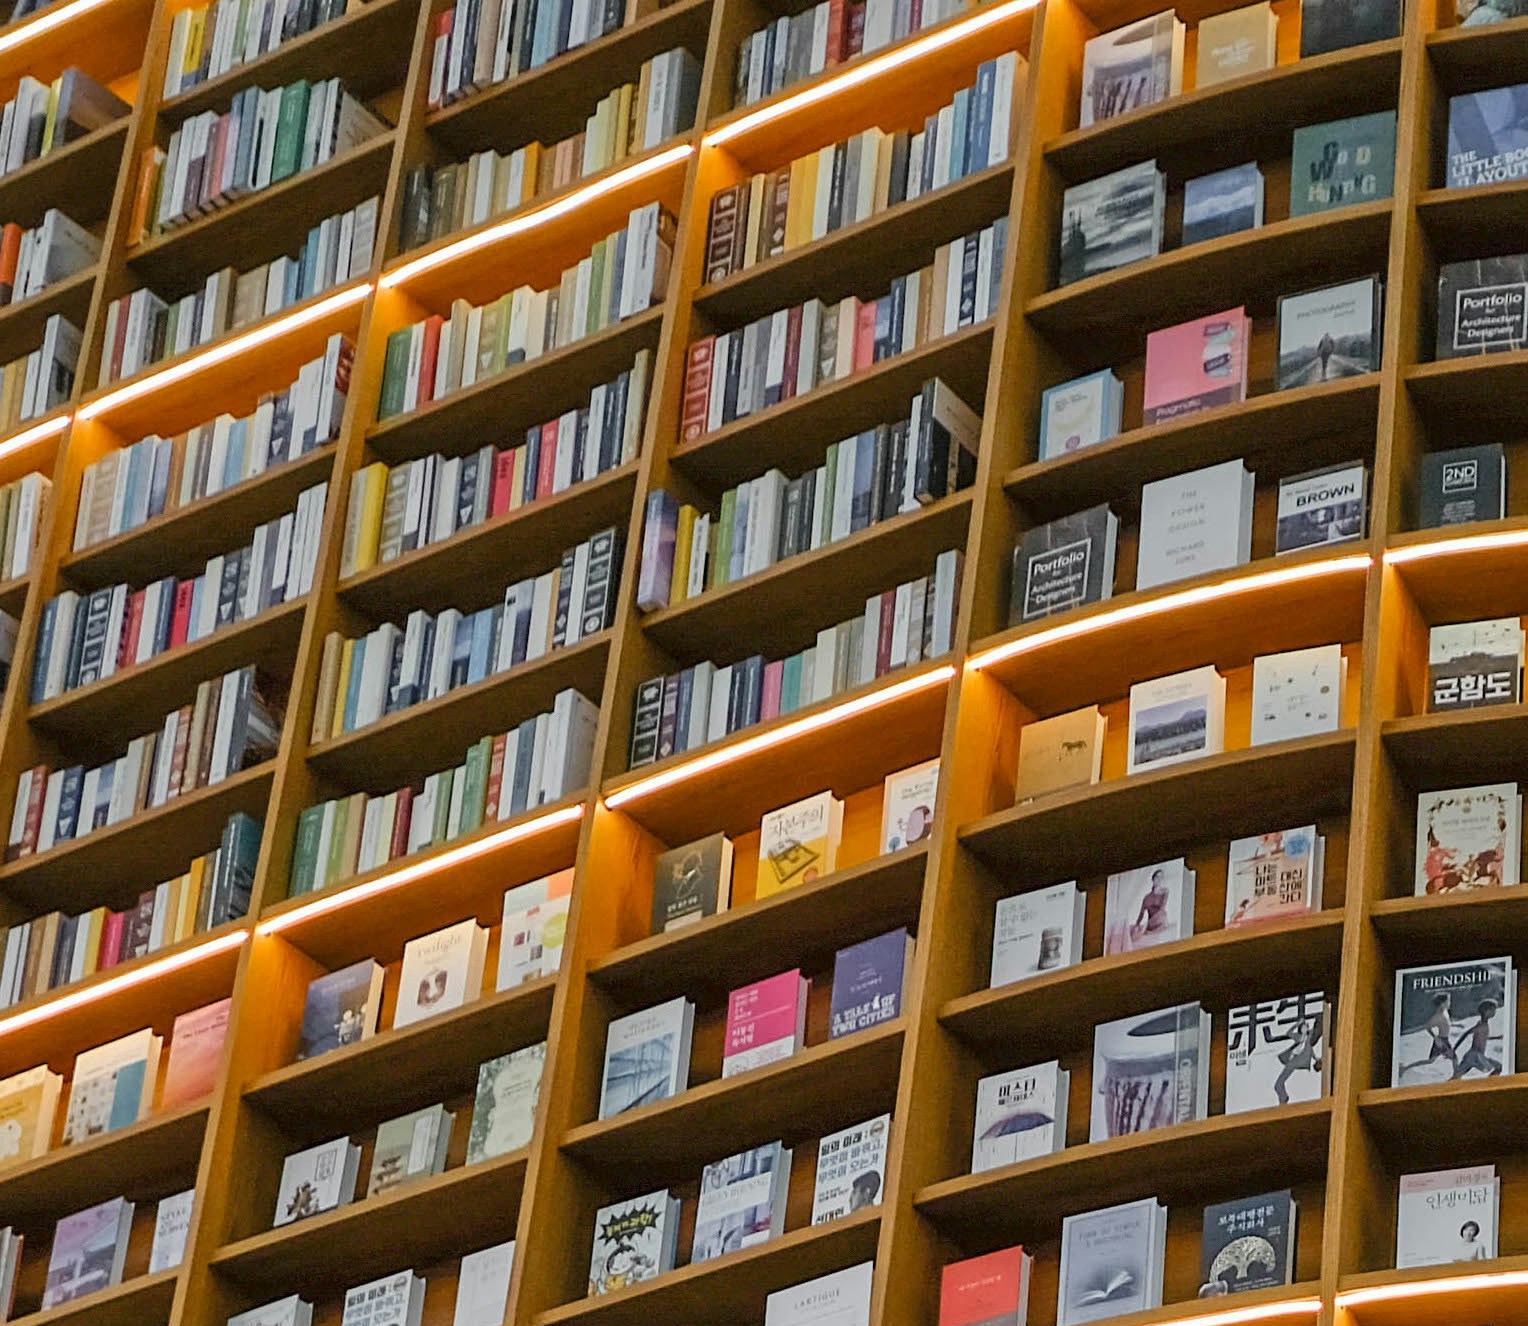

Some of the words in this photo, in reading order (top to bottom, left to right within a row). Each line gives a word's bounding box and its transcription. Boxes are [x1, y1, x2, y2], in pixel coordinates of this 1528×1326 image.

[1453, 156, 1500, 179] LITTLE
[1462, 292, 1523, 311] Portfolio
[1460, 313, 1522, 330] Architecture
[1295, 483, 1355, 508] BROWN
[1033, 551, 1086, 578] Portfolio
[1030, 573, 1083, 596] Architecture
[1432, 670, 1512, 704] 군함도
